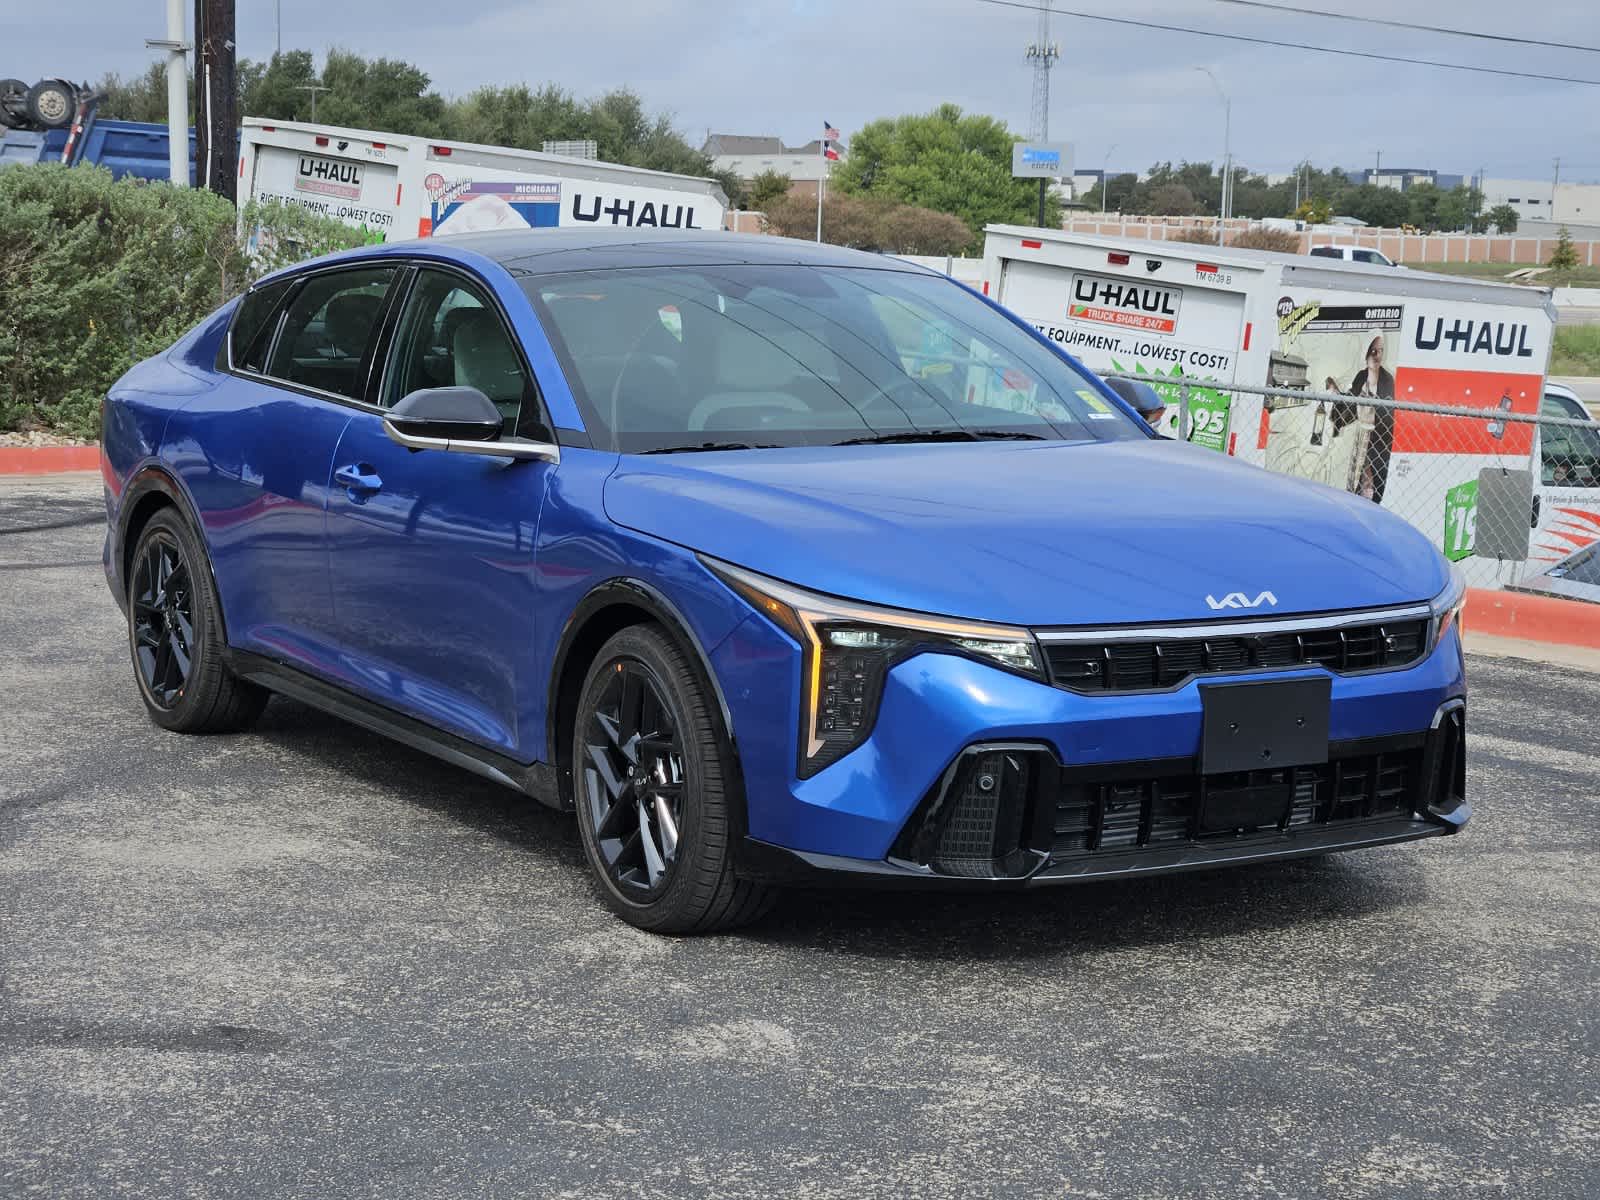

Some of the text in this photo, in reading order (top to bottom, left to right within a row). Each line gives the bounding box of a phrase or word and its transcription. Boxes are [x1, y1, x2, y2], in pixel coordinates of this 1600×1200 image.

[300, 159, 360, 184] U-HAUL
[515, 184, 558, 194] MICHIGAN
[369, 211, 393, 227] COST!
[573, 194, 702, 230] U-HAUL
[1075, 279, 1175, 315] U-HAUL
[1087, 308, 1163, 329] TRUCK SHARE 24/7
[1365, 308, 1400, 319] ONTARIO
[1415, 316, 1533, 357] U-HAUL
[1134, 342, 1186, 363] LOWEST
[1189, 351, 1229, 370] COST!
[1205, 591, 1278, 609] KIA
